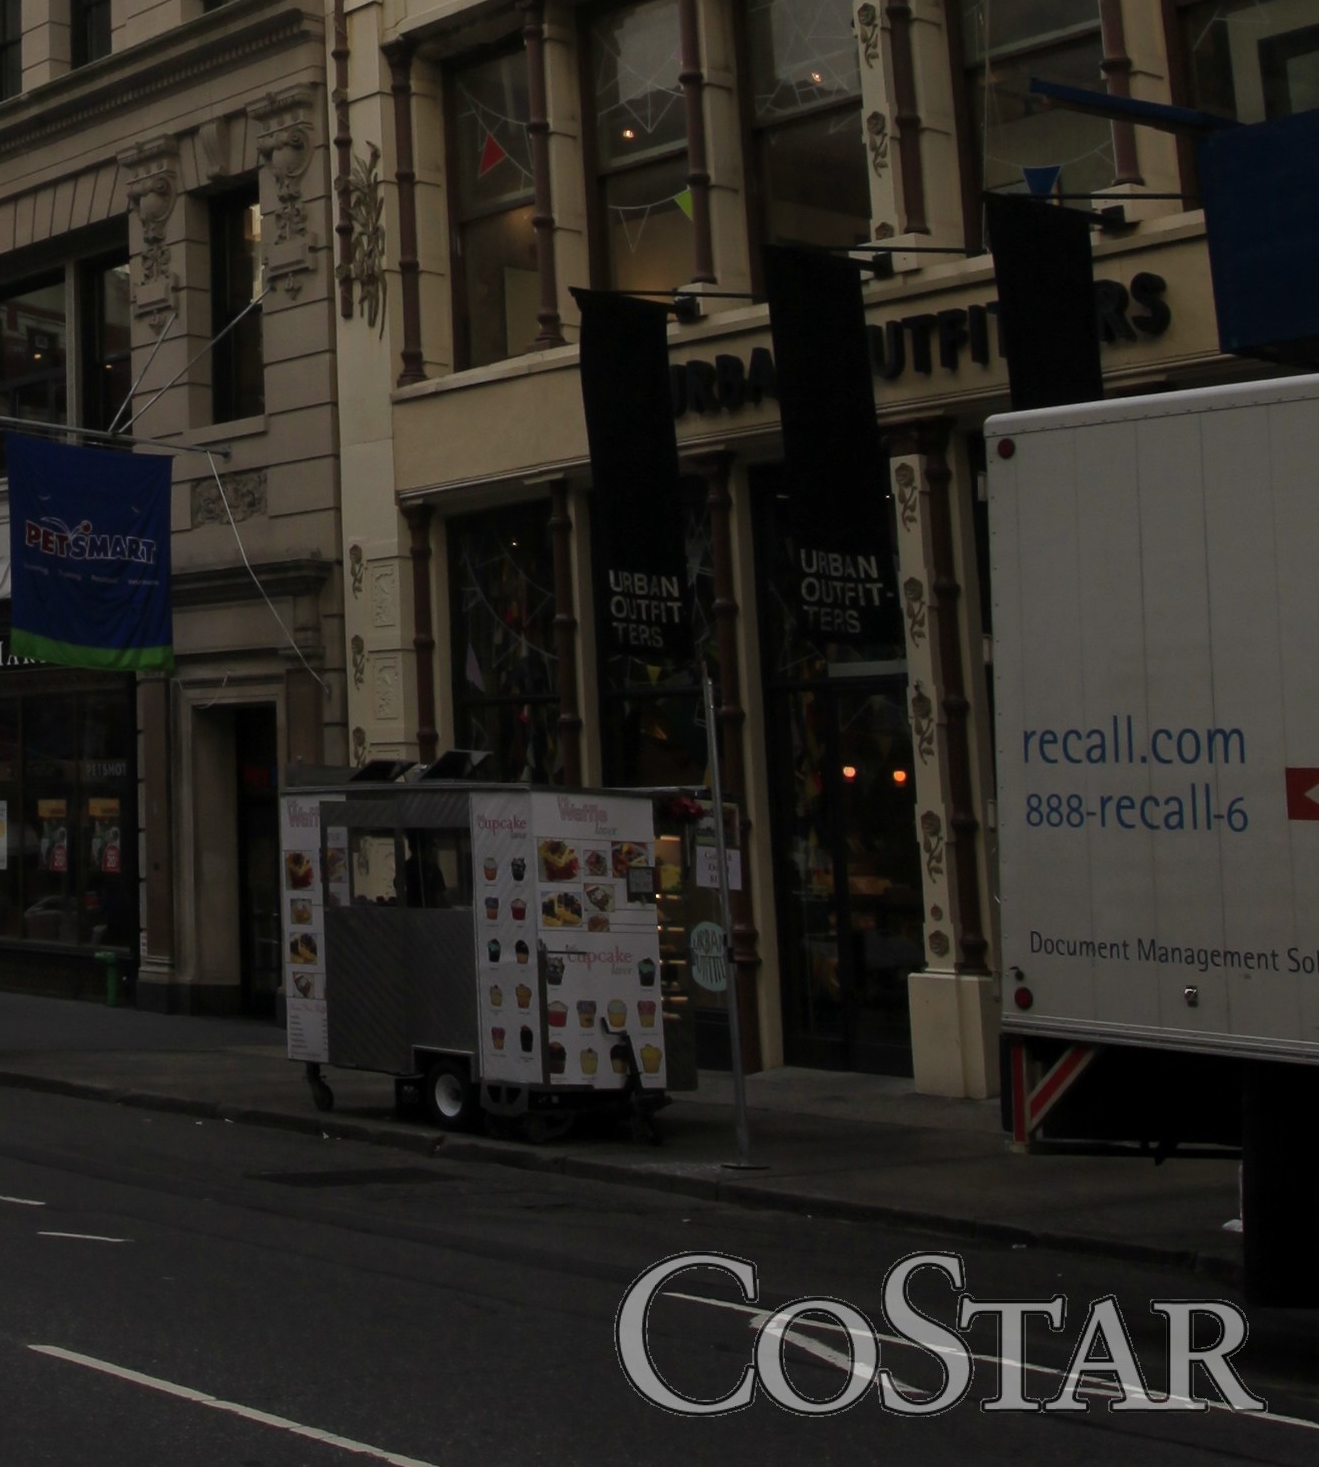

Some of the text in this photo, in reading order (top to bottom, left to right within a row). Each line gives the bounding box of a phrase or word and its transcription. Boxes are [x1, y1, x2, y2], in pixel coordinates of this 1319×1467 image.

[668, 347, 780, 418] URBA
[25, 519, 157, 564] PETSMART
[800, 548, 879, 579] URBAN
[608, 569, 681, 598] URBAN
[800, 576, 895, 607] OUTFIT-
[612, 621, 665, 648] TERS
[802, 604, 863, 634] TERS
[1023, 715, 1247, 764] recall.com
[1025, 782, 1250, 833] 888-recall-6
[1030, 930, 1130, 961] Document
[1138, 938, 1280, 972] Management
